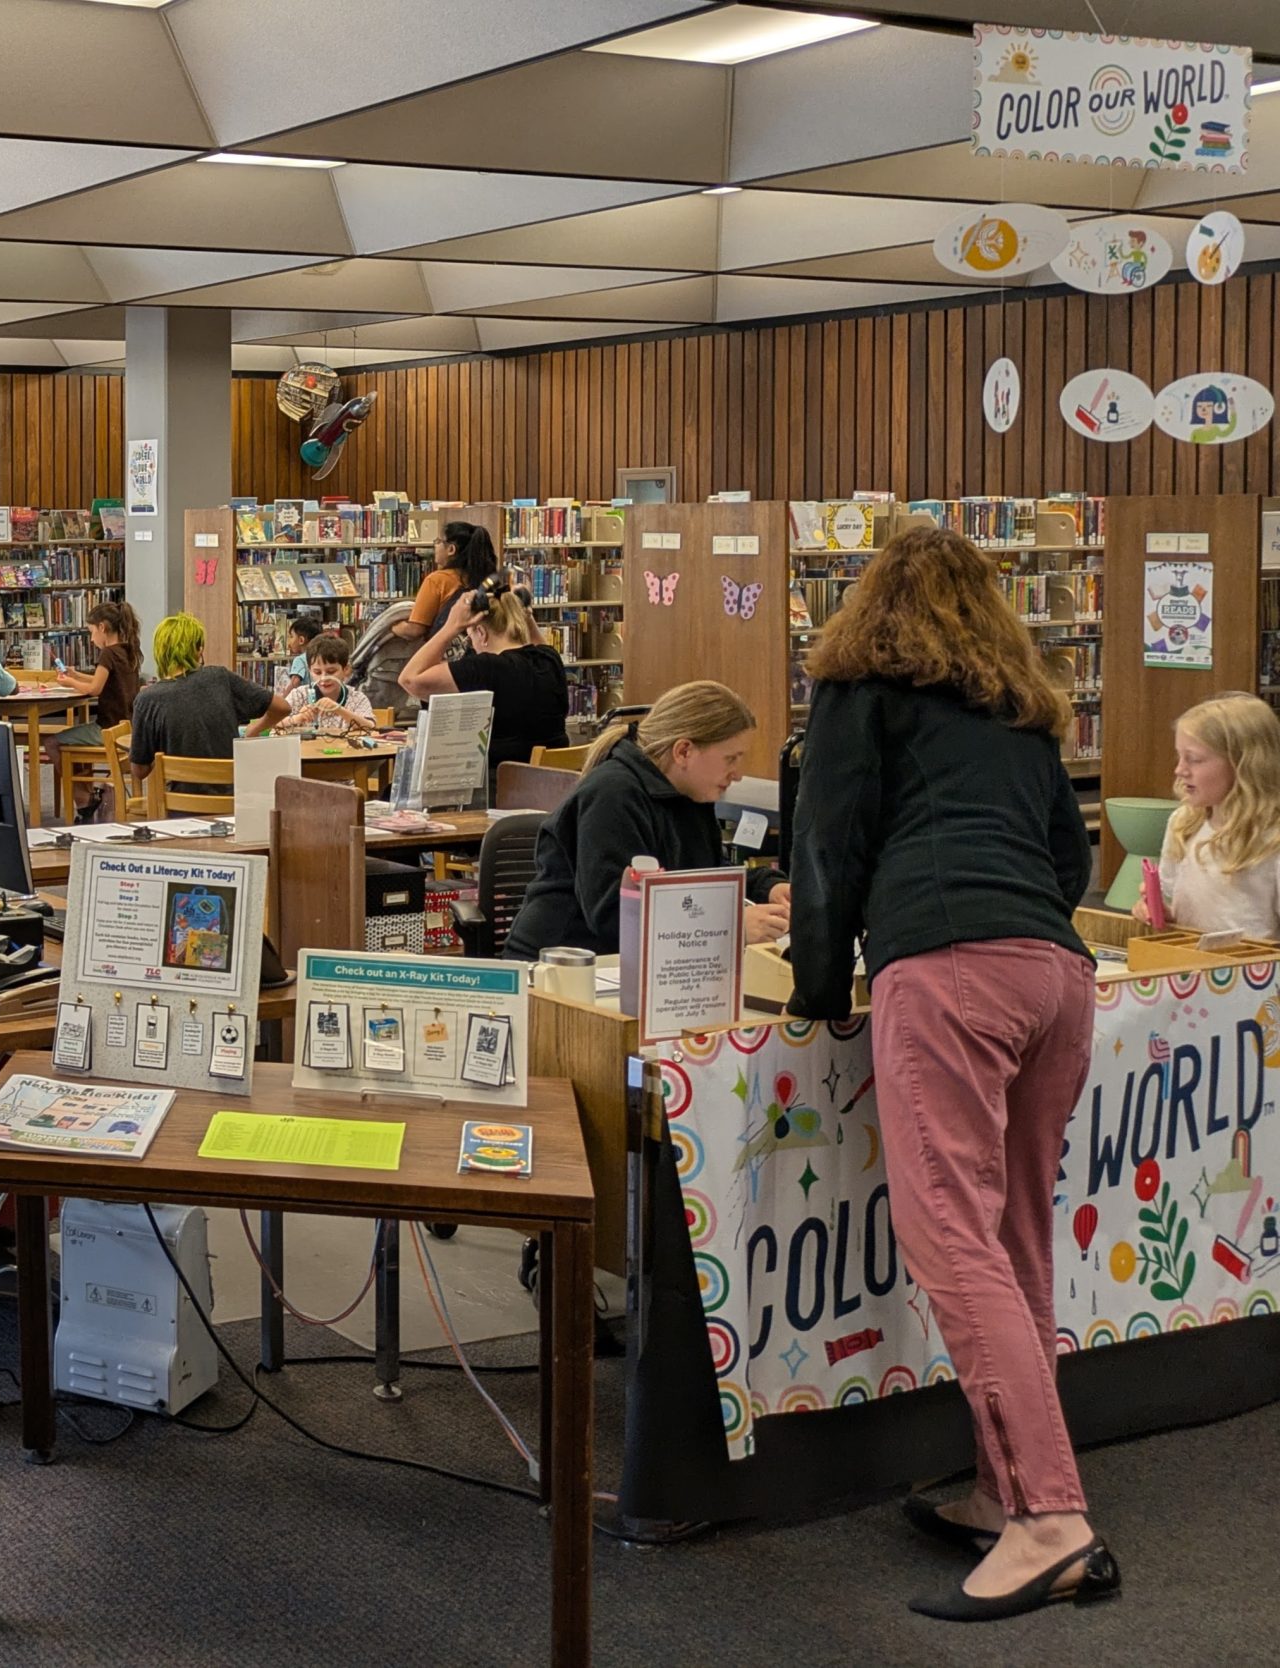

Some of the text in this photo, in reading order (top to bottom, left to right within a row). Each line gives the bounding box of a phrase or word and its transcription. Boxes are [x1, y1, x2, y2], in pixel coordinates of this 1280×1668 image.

[997, 60, 1226, 140] COLOR OUR WORLD
[134, 475, 152, 485] WORLD
[1163, 606, 1195, 615] READS
[100, 861, 126, 873] Check
[128, 863, 143, 874] Out
[153, 866, 188, 878] Literacy
[191, 868, 204, 878] Kit
[206, 869, 235, 882] Today!
[658, 929, 728, 941] Holiday Closure
[678, 939, 707, 948] Notice
[335, 965, 480, 985] Check out an X-Ray Kit Today!
[661, 964, 707, 972] Independence
[669, 977, 691, 985] closed
[19, 1080, 158, 1101] New Mexico Kids!
[1088, 1019, 1265, 1197] WORLD
[747, 1183, 912, 1360] COLO
